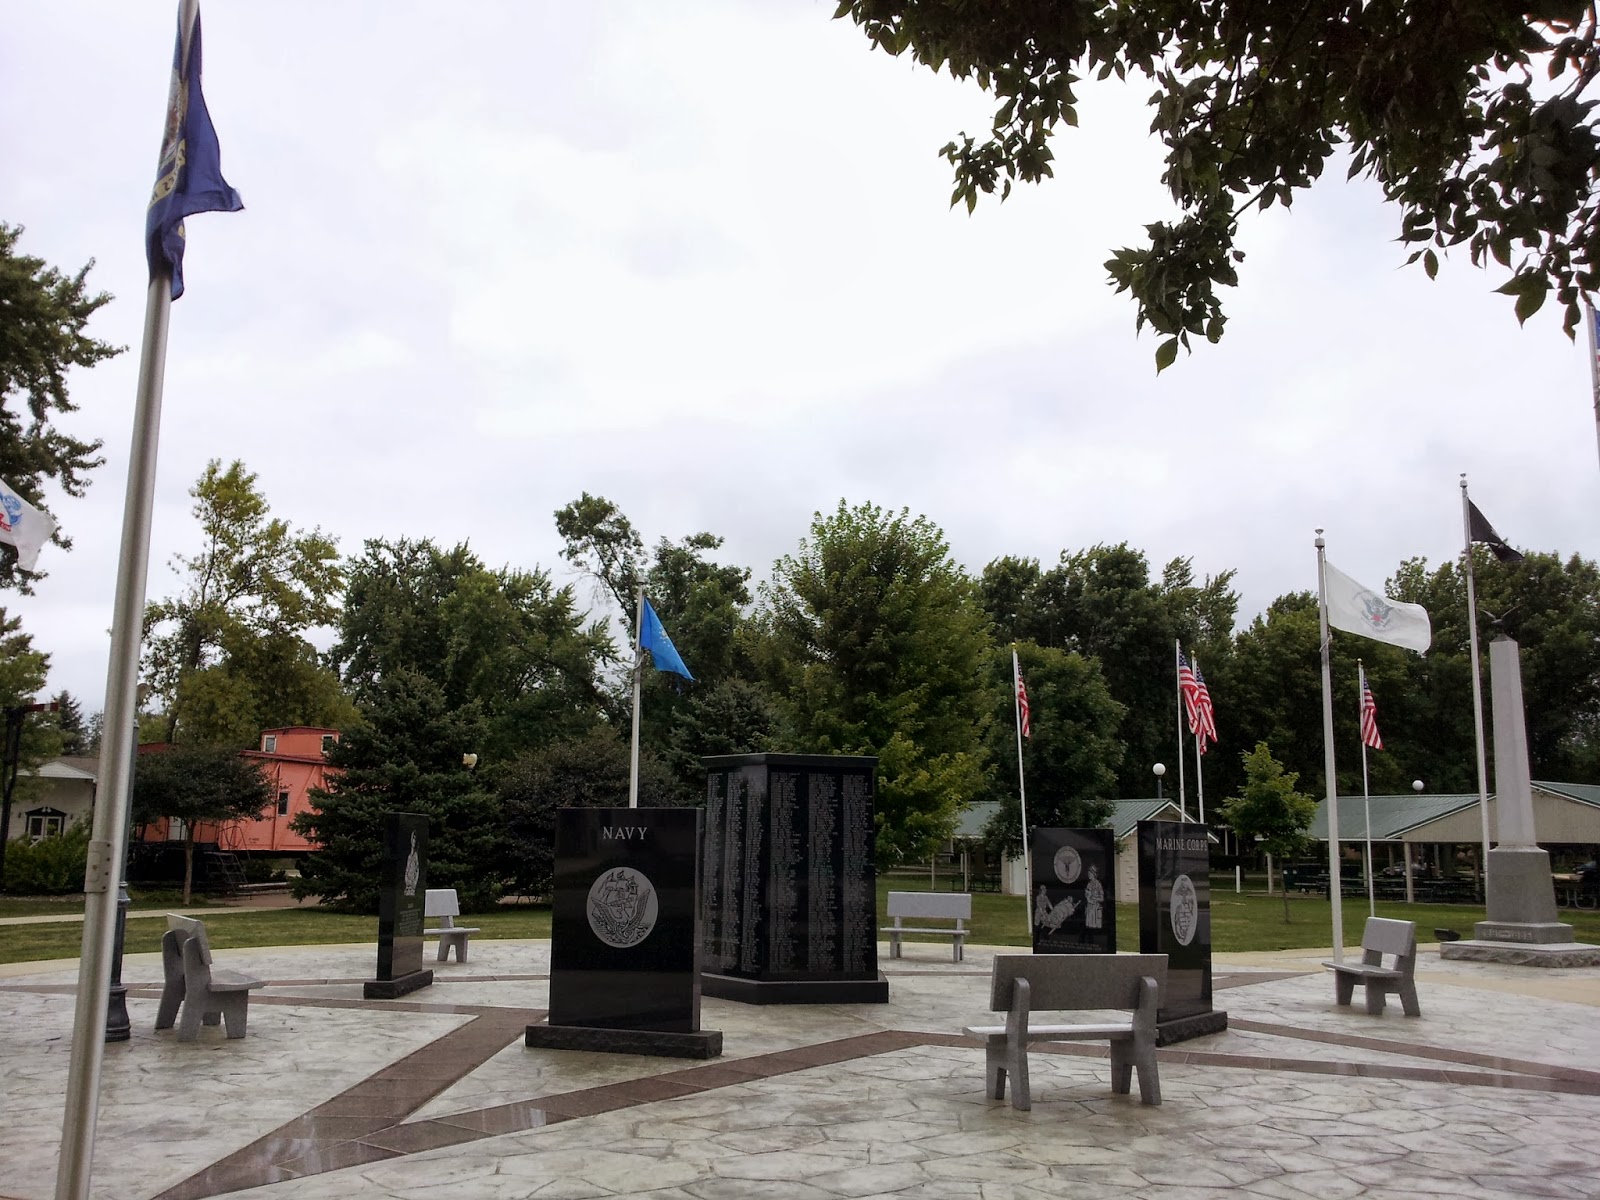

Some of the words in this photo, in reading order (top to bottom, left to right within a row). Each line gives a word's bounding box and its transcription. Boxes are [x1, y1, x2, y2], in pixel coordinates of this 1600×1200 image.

[602, 825, 648, 841] NAVY
[1155, 837, 1185, 851] MARINE
[1186, 838, 1208, 852] CORPS
